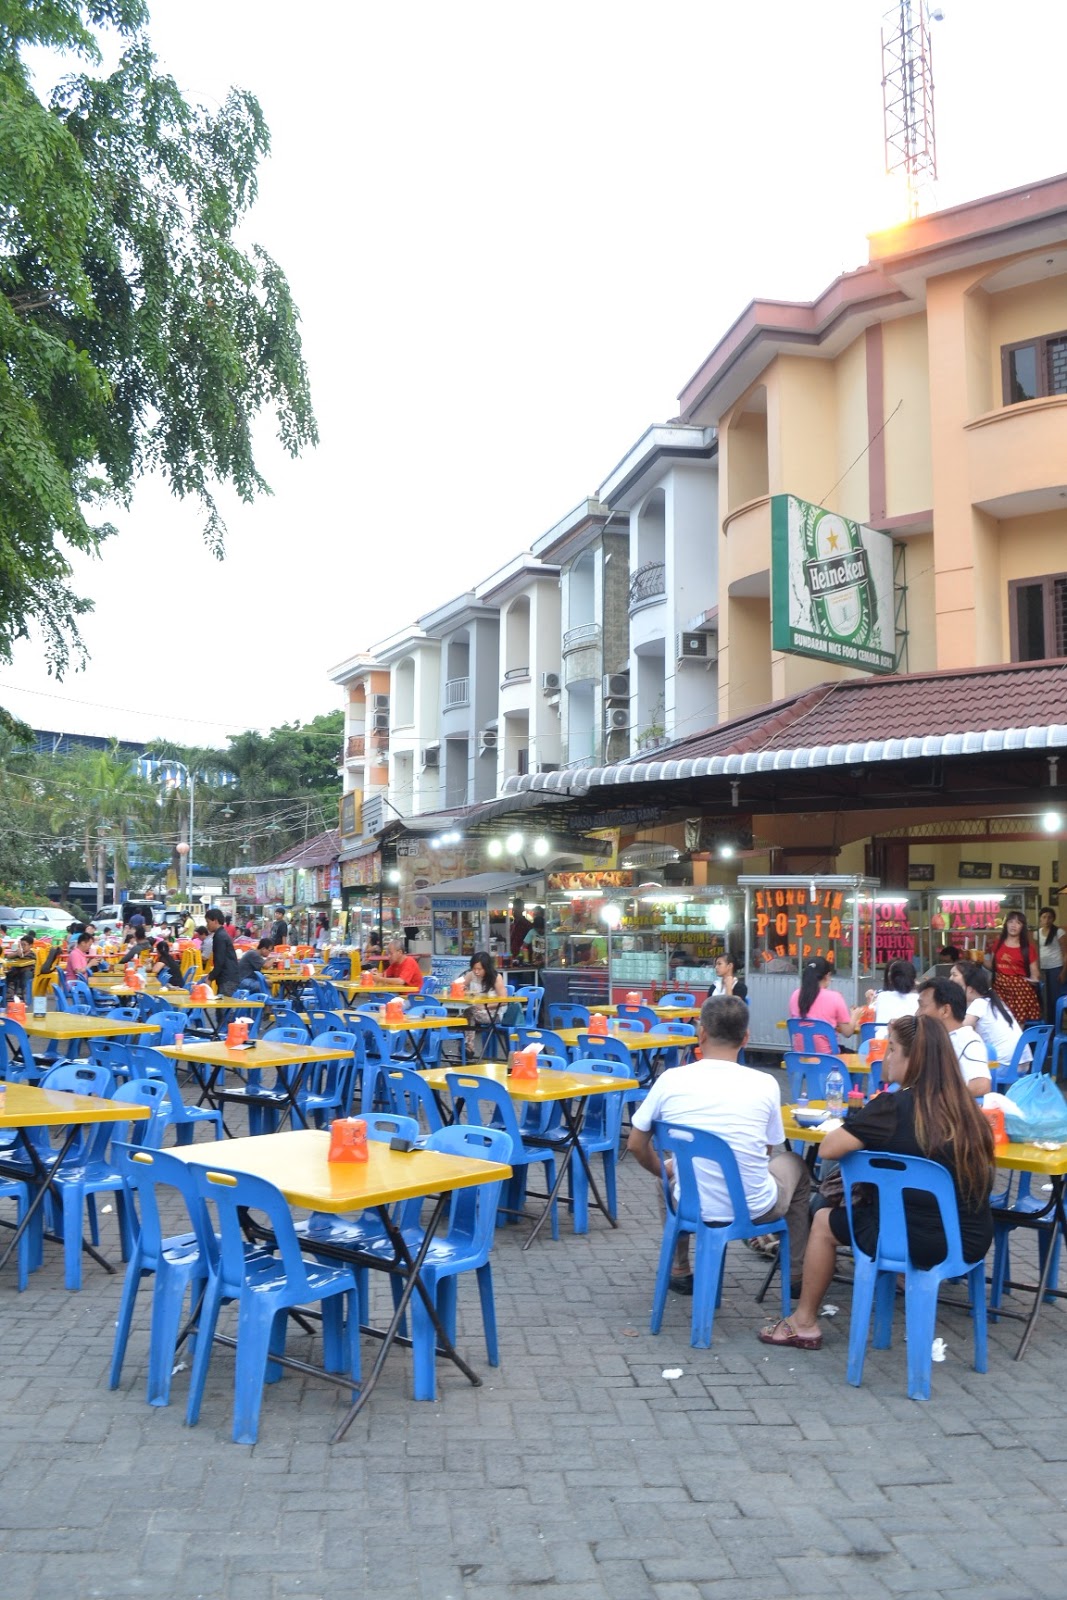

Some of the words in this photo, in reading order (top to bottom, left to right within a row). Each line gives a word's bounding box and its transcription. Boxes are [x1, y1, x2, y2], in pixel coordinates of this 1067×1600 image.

[809, 559, 866, 592] Heineken
[793, 633, 828, 652] BUNDARAN
[828, 641, 842, 656] NICE
[842, 645, 858, 659] FOOD
[858, 649, 880, 665] CEMARA
[880, 655, 893, 669] ASRI
[756, 912, 842, 940] POPIA
[760, 943, 836, 964] LUMPIA
[875, 934, 915, 949] BIHUN
